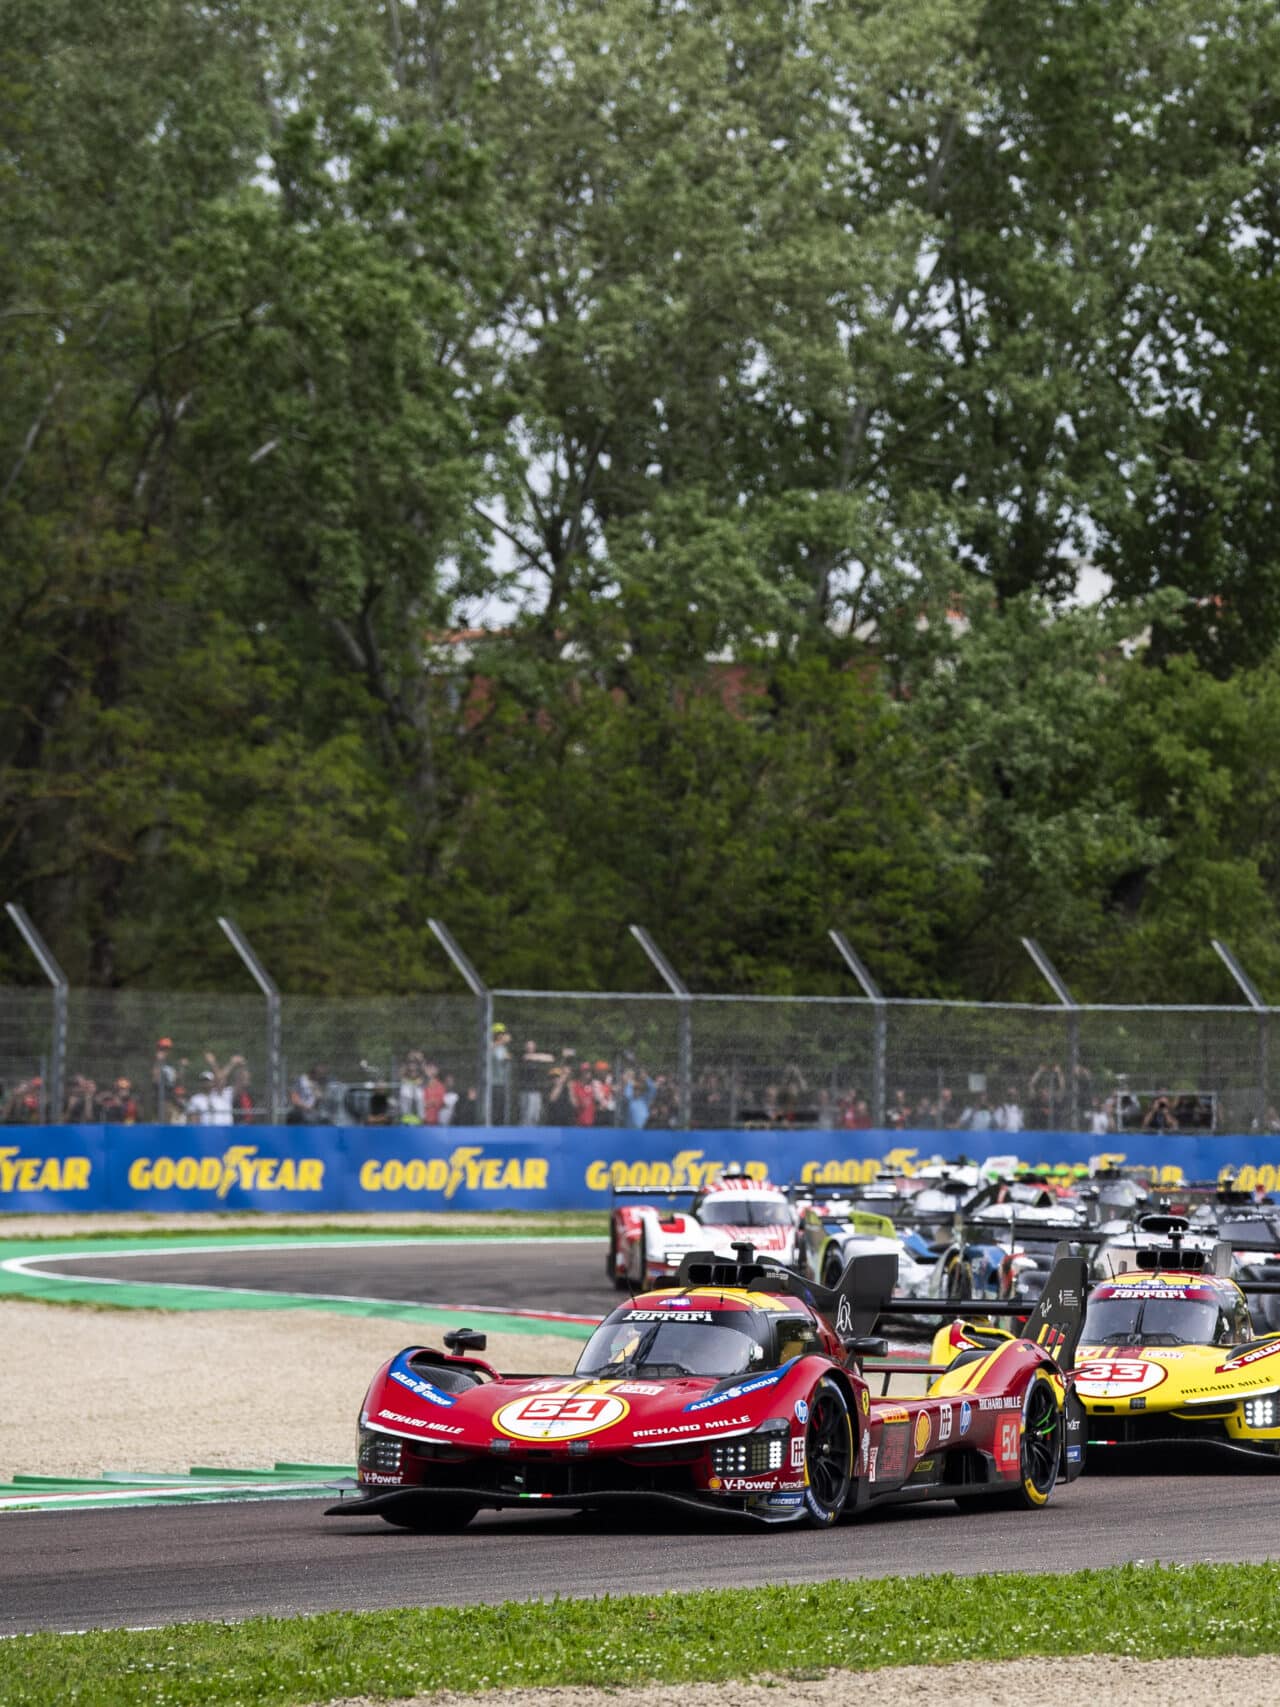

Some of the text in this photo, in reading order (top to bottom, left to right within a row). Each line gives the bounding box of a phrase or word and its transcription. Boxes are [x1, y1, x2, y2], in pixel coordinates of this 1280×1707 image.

[0, 1154, 91, 1192] YEAR
[128, 1153, 325, 1194] GOODYEAR
[360, 1154, 550, 1194] GOODYEAR
[1109, 1289, 1187, 1299] Ferrari
[622, 1310, 713, 1322] Ferrari
[389, 1371, 452, 1406] ADLER GROUP
[690, 1377, 779, 1411] ADLER GROUP
[1180, 1376, 1273, 1395] RICHARD MILLE
[521, 1399, 600, 1420] 51
[979, 1396, 1022, 1411] RICHARD MILLE
[378, 1409, 465, 1435] RICHARD MILLE
[632, 1415, 752, 1438] RICHARD MILLE
[1001, 1424, 1019, 1462] 51
[363, 1472, 403, 1484] V-Power
[724, 1479, 776, 1490] V-Power
